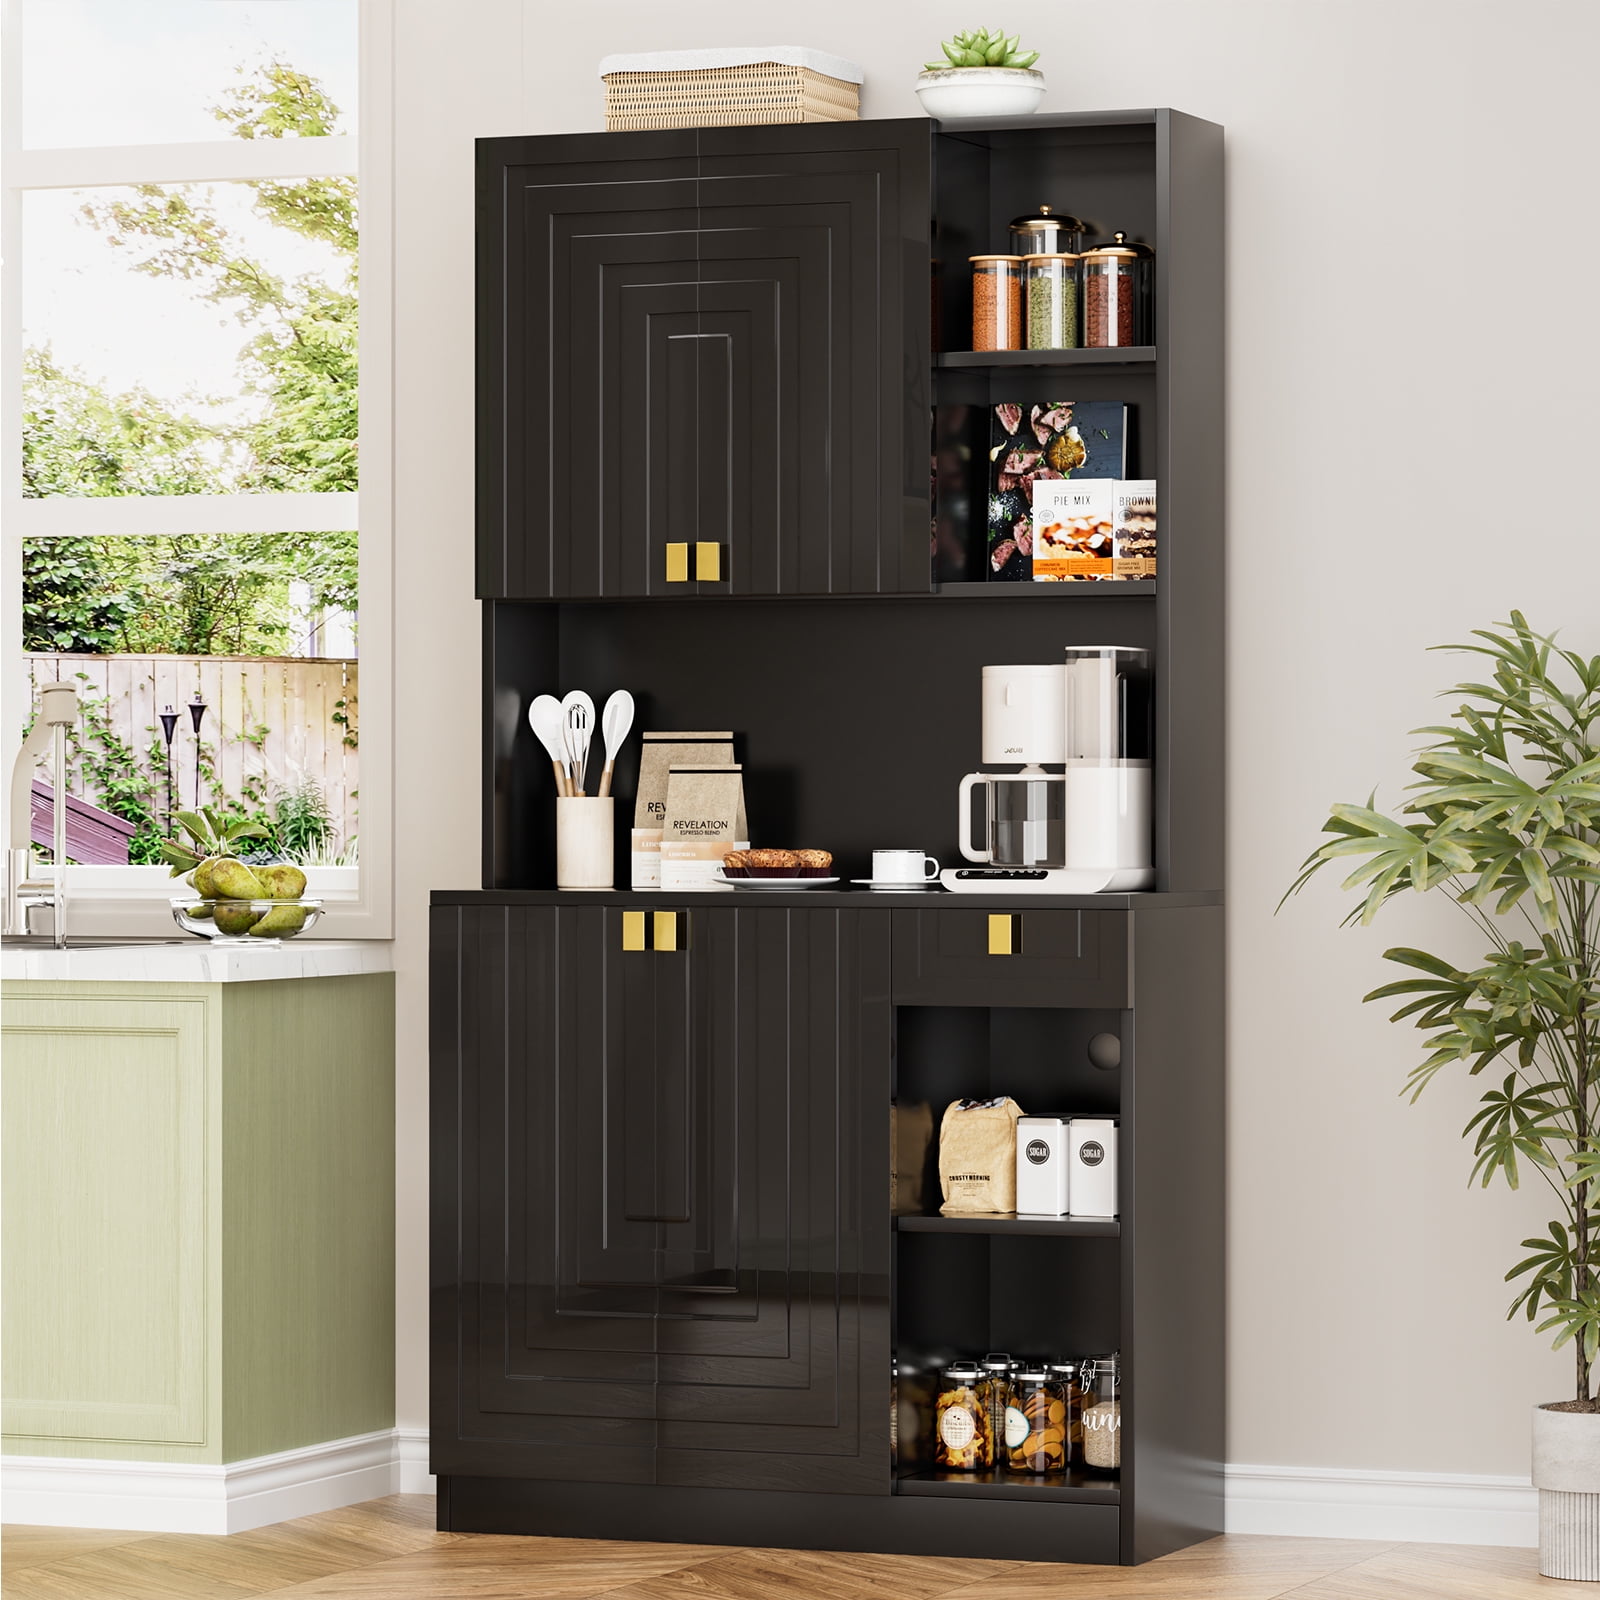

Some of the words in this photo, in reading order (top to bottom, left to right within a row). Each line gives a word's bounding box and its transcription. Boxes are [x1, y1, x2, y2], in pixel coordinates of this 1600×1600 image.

[1054, 496, 1068, 506] PIE
[1074, 495, 1091, 505] MIX
[673, 820, 729, 830] REVELATION
[1029, 1147, 1047, 1157] SUGAR
[1083, 1148, 1101, 1159] SUGAR
[1082, 1410, 1120, 1433] uin
